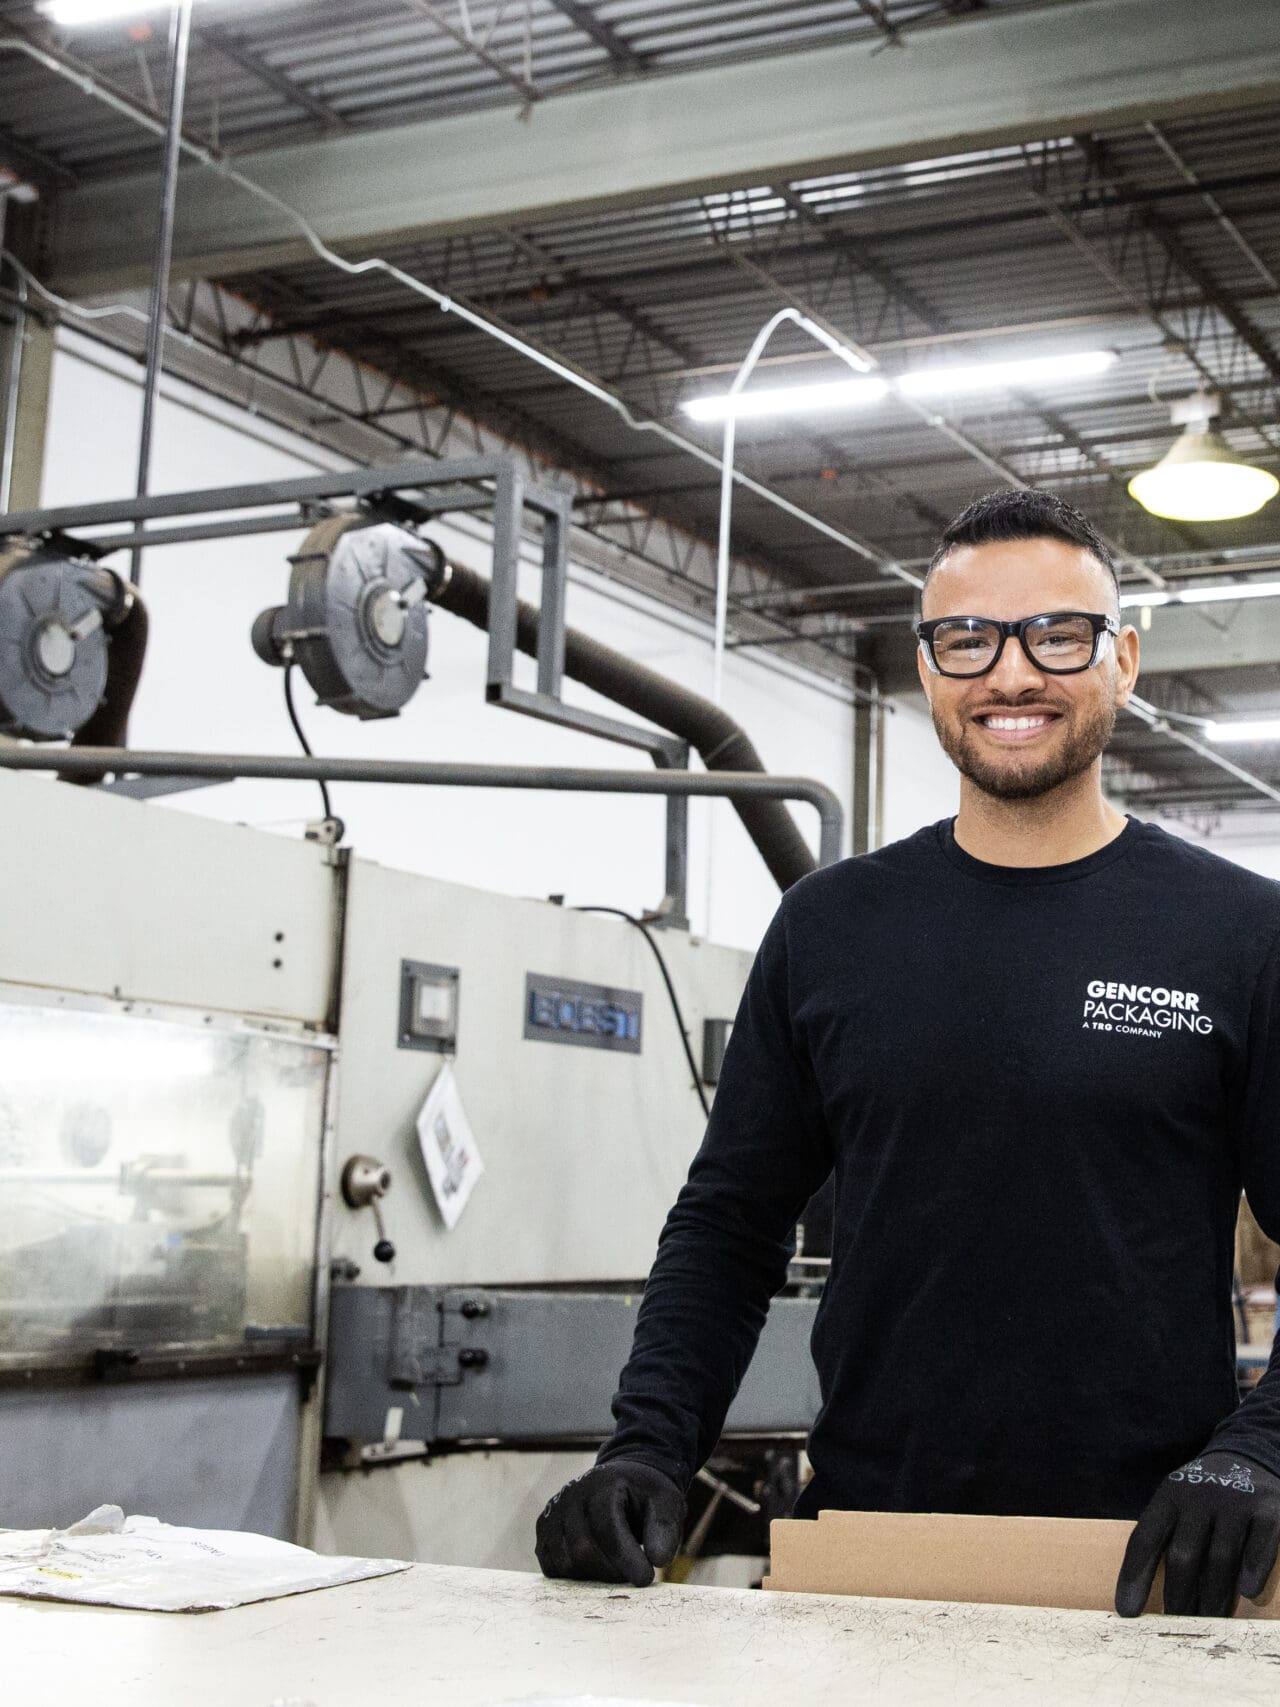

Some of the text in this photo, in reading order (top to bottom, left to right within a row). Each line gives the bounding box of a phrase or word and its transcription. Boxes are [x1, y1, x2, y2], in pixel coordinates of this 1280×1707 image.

[1086, 980, 1200, 1012] GENCORR
[1082, 1021, 1090, 1029] A
[1115, 1024, 1163, 1039] COMPANY
[1083, 1000, 1214, 1034] PACKAGING
